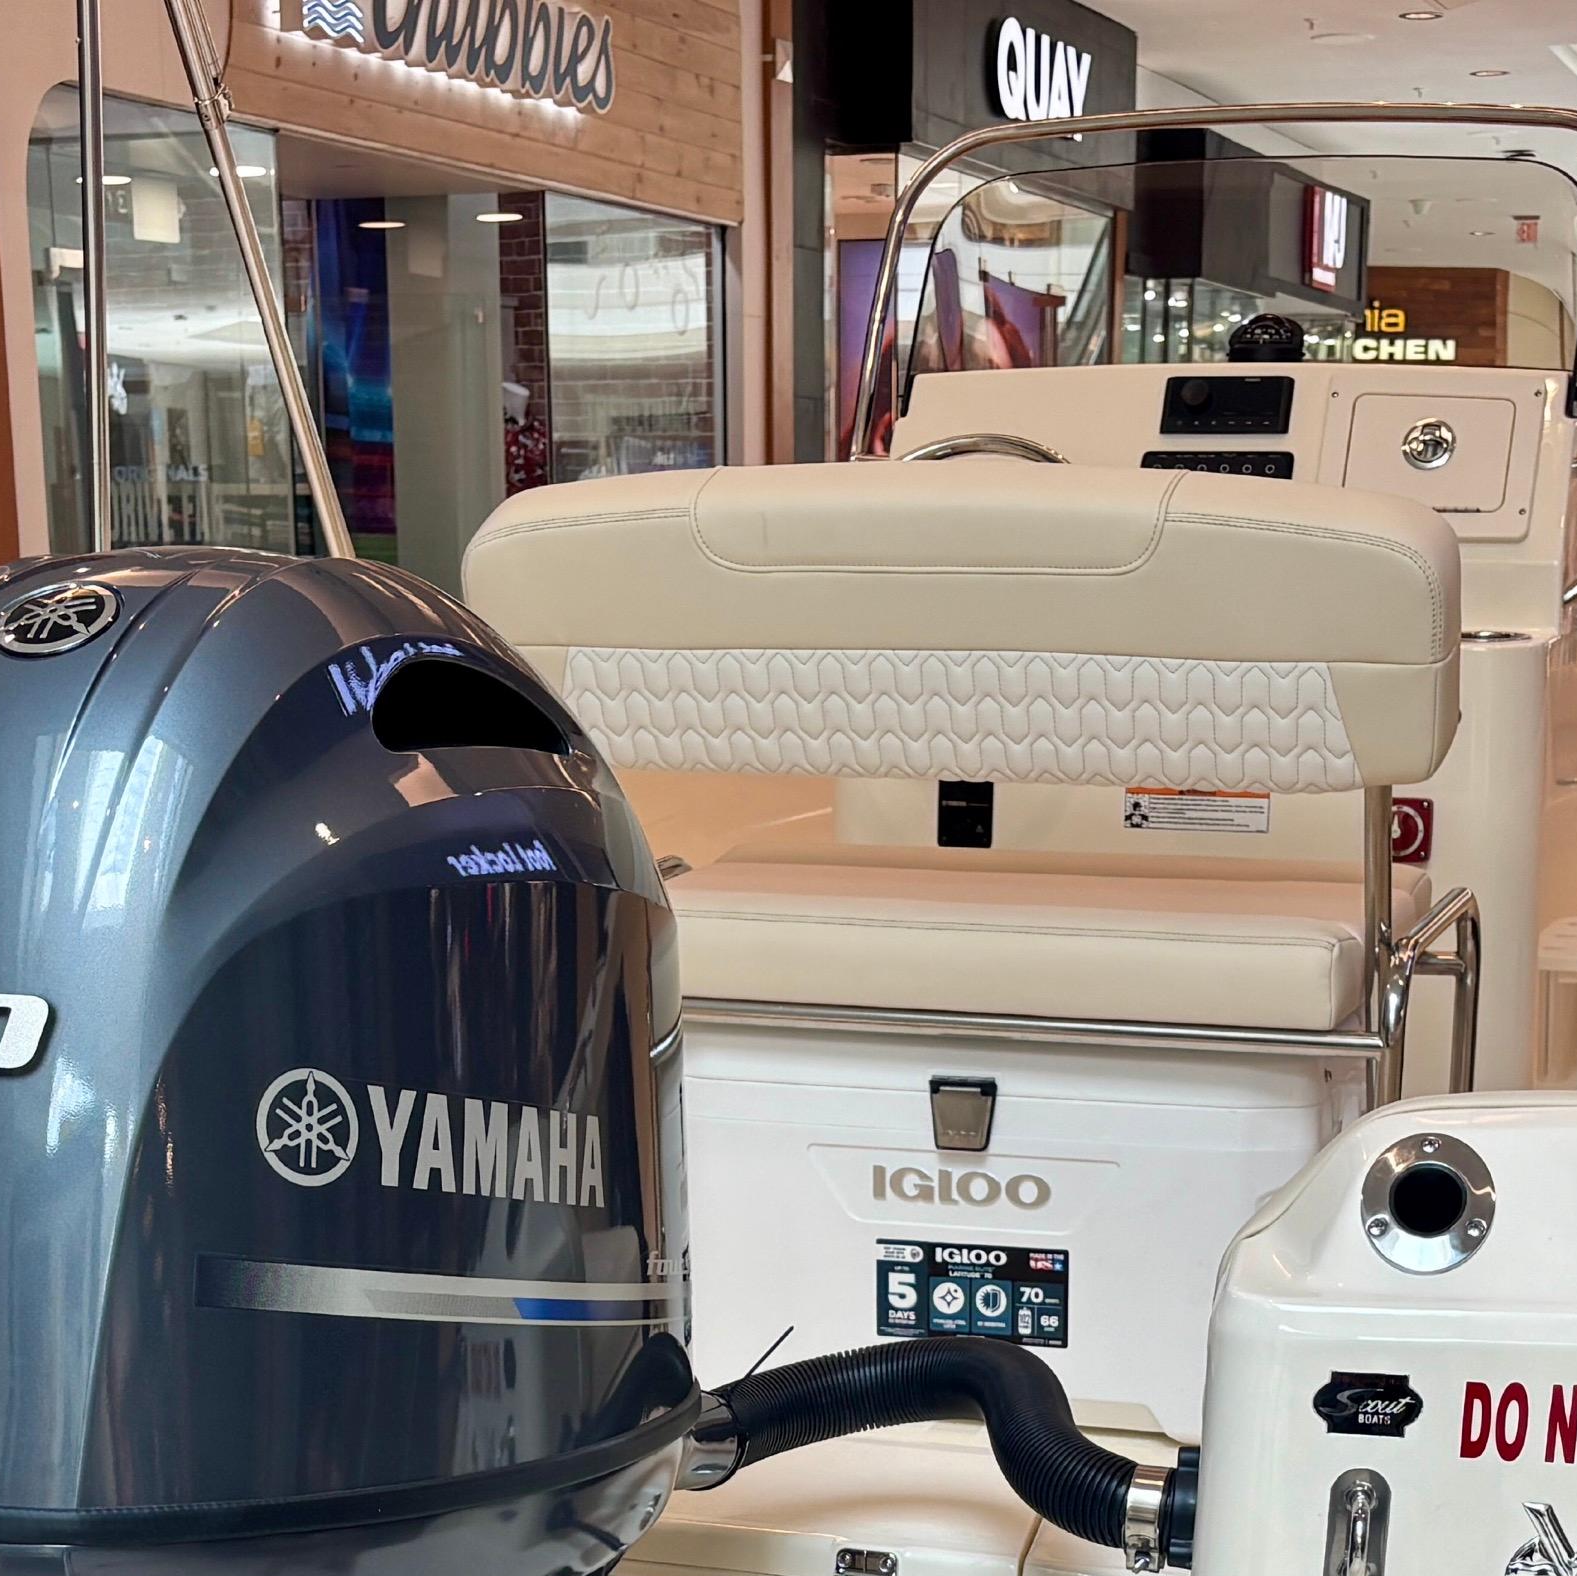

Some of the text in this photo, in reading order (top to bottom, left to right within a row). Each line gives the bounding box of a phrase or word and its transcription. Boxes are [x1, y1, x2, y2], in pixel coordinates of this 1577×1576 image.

[997, 17, 1091, 142] QUAY
[1352, 338, 1457, 361] CHEN
[367, 1084, 605, 1208] YAMAHA
[872, 1164, 1052, 1211] IGLOO
[935, 1247, 1008, 1267] IGLOO
[888, 1272, 917, 1309] 5
[1019, 1287, 1044, 1303] 70
[888, 1309, 916, 1320] DAYS
[1040, 1315, 1059, 1327] 66
[1319, 1388, 1416, 1416] Scout
[1358, 1413, 1391, 1425] BOATS
[1459, 1381, 1529, 1462] DO
